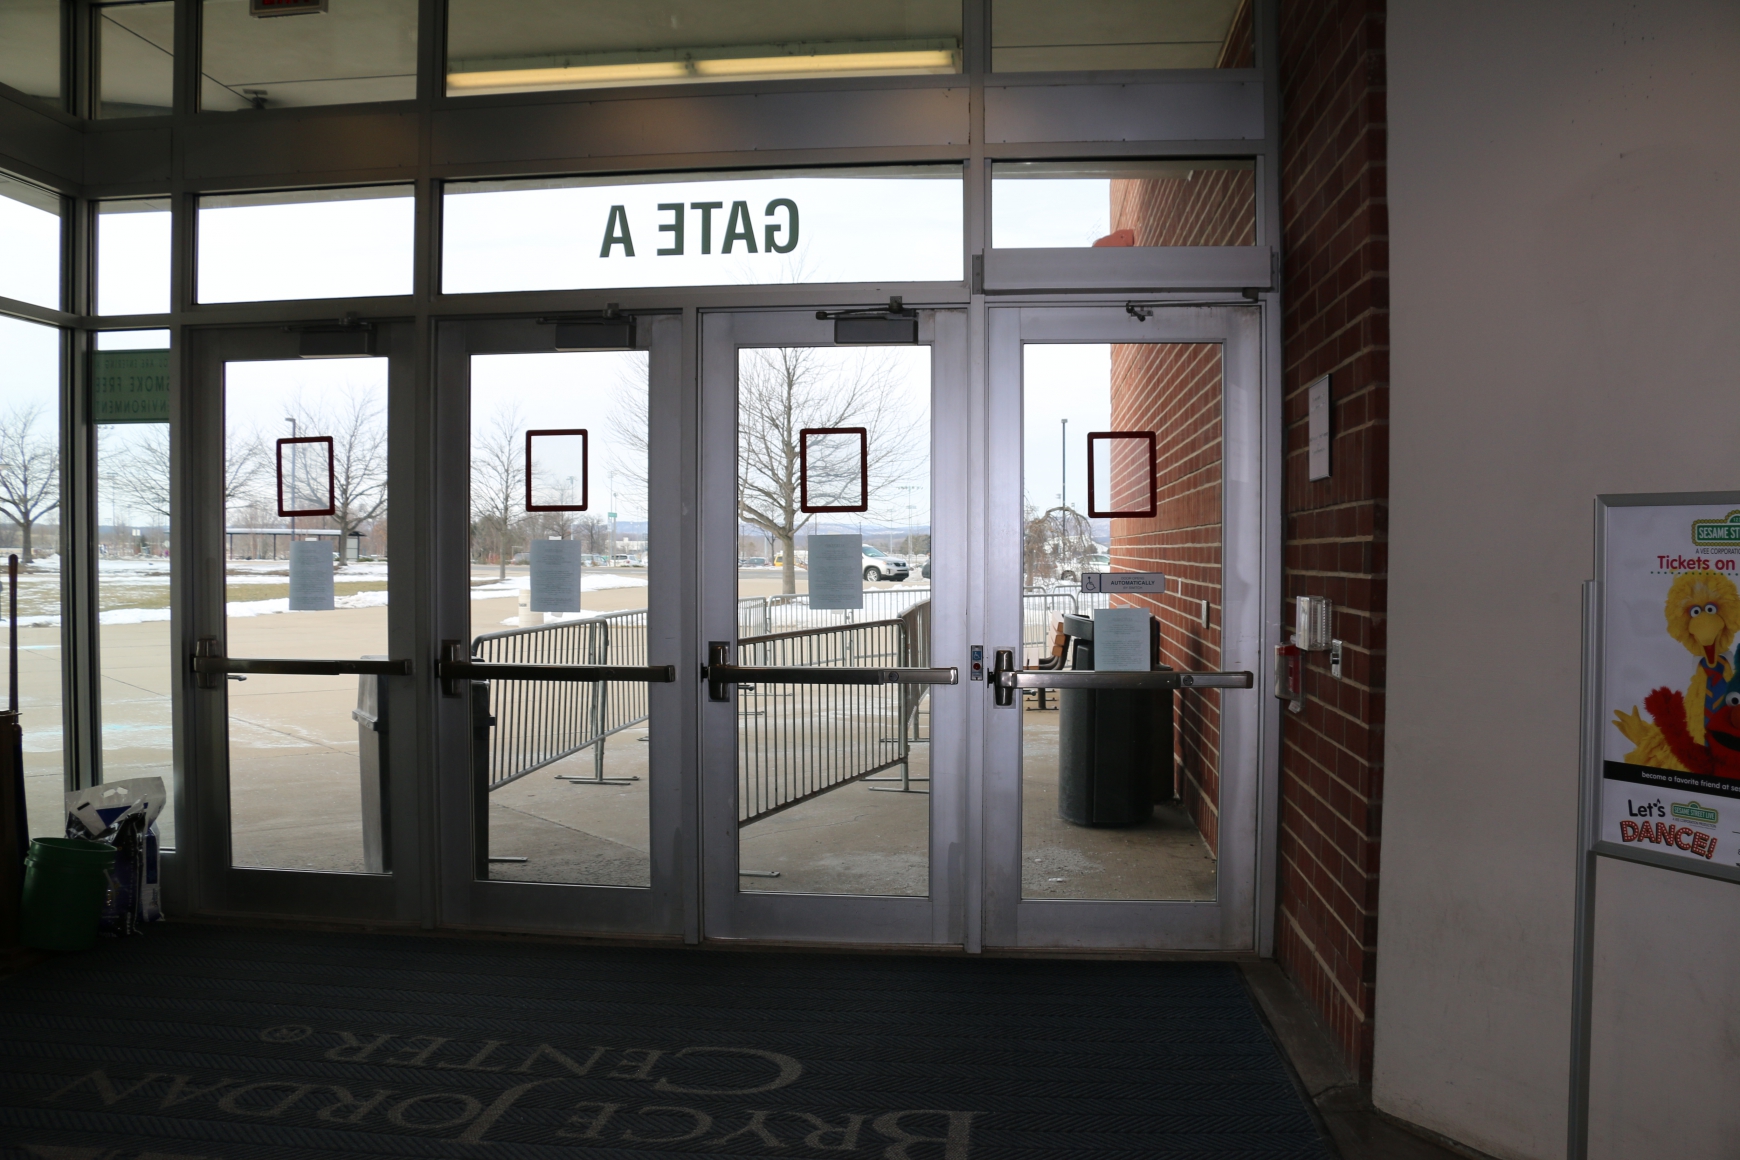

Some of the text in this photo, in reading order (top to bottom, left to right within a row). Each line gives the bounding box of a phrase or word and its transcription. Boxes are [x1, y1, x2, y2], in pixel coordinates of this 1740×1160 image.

[1698, 527, 1729, 539] SESAME
[1657, 555, 1736, 571] Tickets on
[1641, 771, 1667, 781] become
[1674, 776, 1699, 786] favorite
[1700, 780, 1721, 789] friend
[1627, 798, 1666, 817] Let's
[1674, 806, 1690, 815] SESAME
[1690, 810, 1705, 818] STREET
[1620, 820, 1718, 859] DANCE!
[42, 1070, 990, 1160] BRYCE JORDAN
